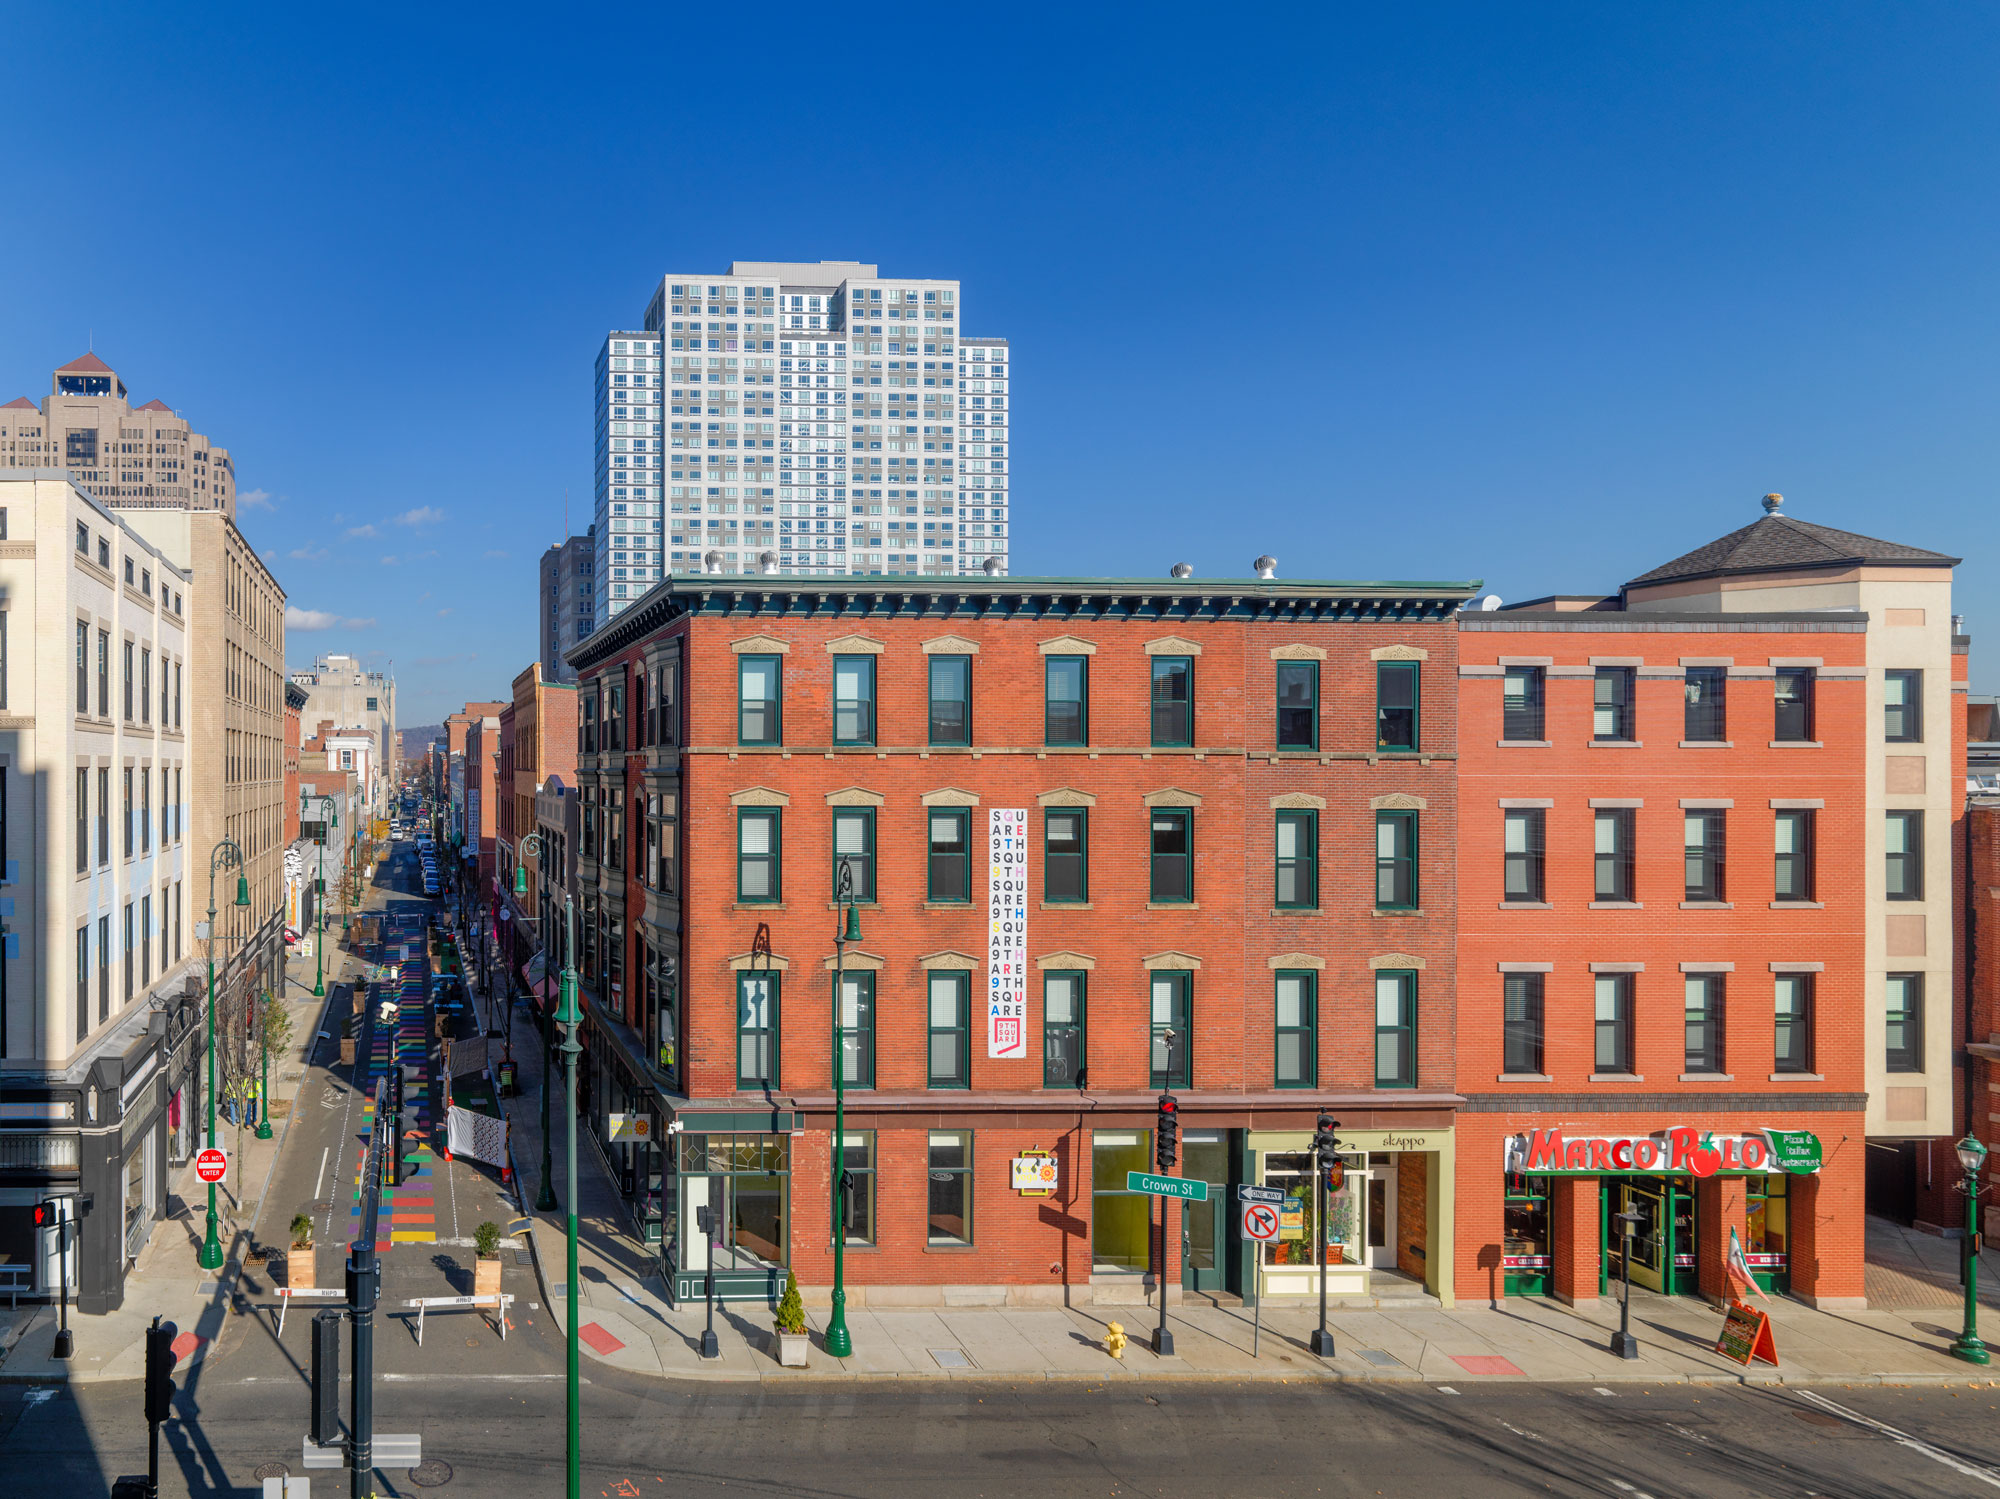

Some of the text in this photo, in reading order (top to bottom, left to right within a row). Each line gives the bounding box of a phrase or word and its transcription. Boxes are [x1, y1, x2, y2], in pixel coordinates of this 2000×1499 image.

[993, 811, 1024, 822] SQU
[992, 825, 1023, 835] ARE
[993, 839, 1023, 849] 9TH
[993, 853, 1023, 864] SQU
[993, 867, 1023, 877] 9TH
[993, 881, 1023, 891] SQU
[992, 894, 1022, 904] ARE
[992, 908, 1023, 918] 9TH
[992, 922, 1023, 933] SQU
[992, 936, 1022, 946] ARE
[992, 950, 1022, 960] 9TH
[991, 964, 1022, 974] ARE
[992, 978, 1022, 988] 9TH
[992, 992, 1022, 1003] SQU
[991, 1006, 1021, 1016] ARE
[611, 1119, 632, 1127] fresh
[1527, 1128, 1658, 1170] MARCO
[1015, 1174, 1038, 1183] yoga
[1142, 1178, 1192, 1195] Crown St
